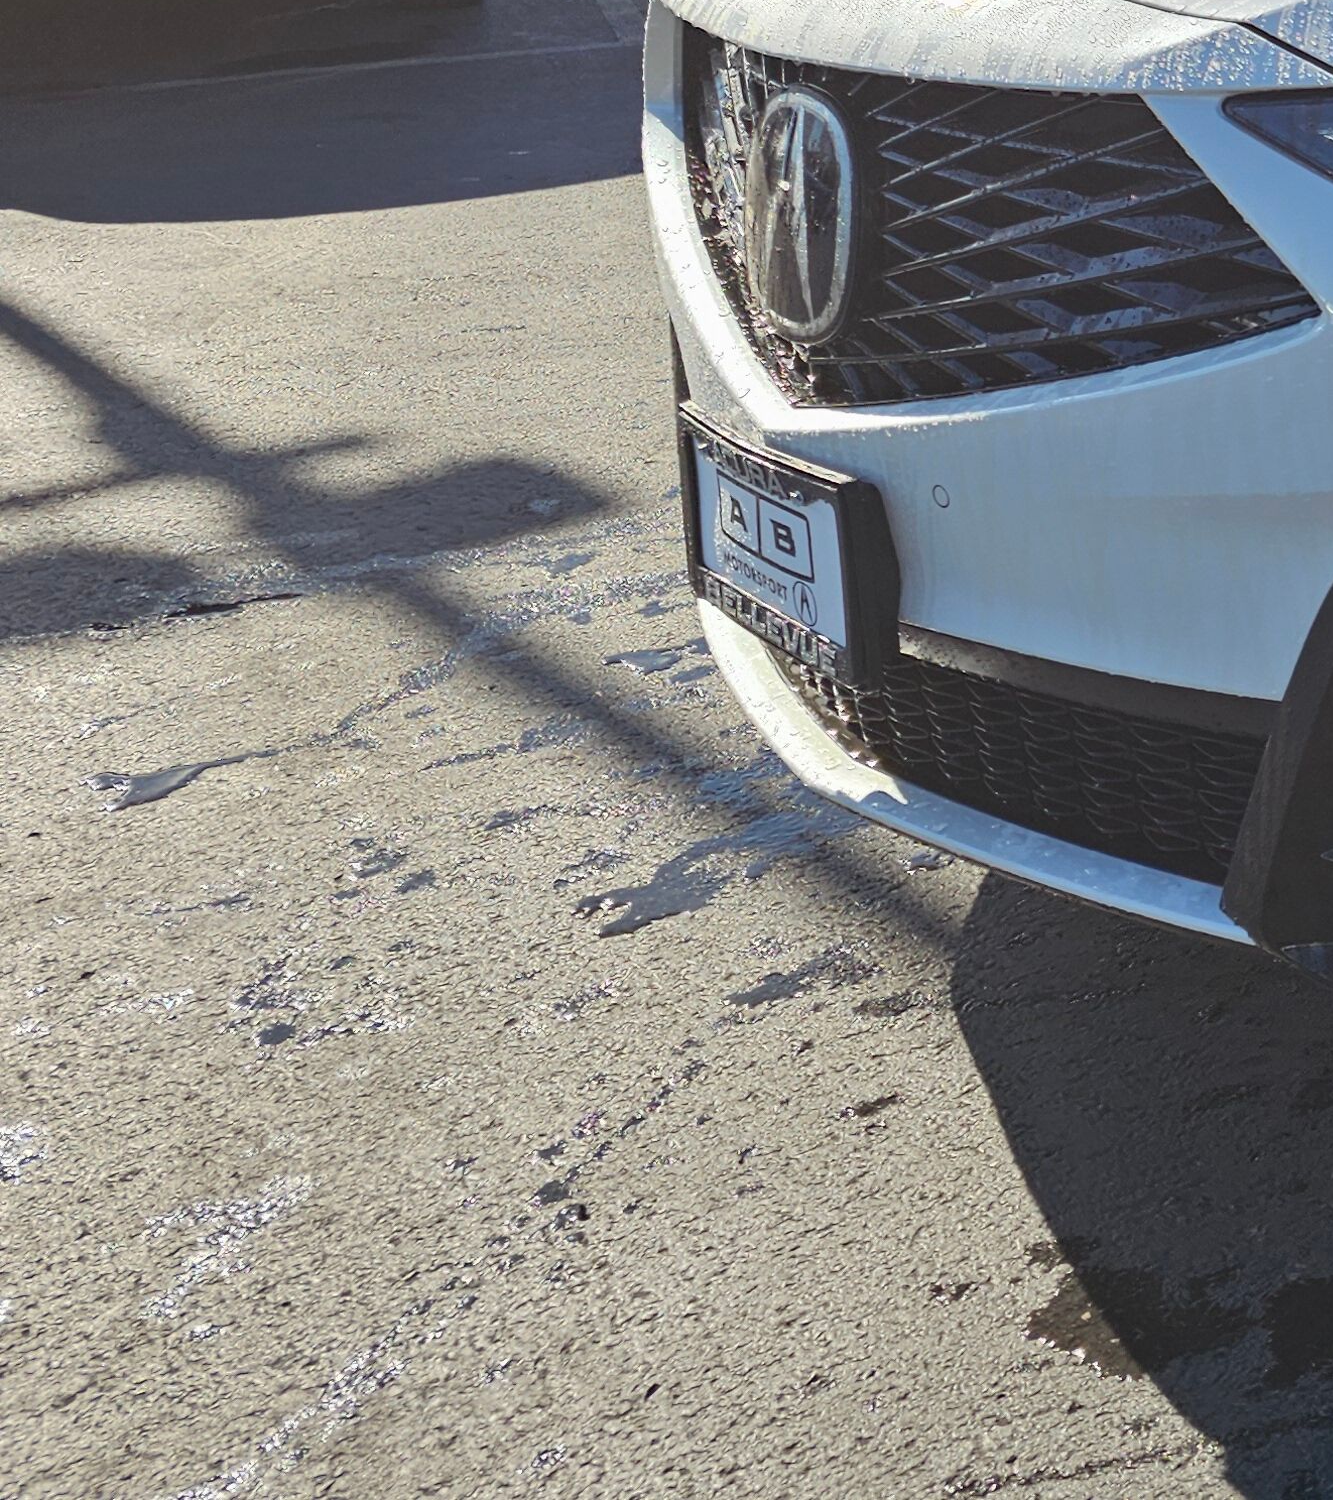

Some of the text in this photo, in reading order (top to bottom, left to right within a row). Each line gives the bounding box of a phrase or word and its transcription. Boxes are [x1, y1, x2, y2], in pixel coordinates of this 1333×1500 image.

[730, 496, 797, 557] A B
[723, 551, 788, 601] MOTORSPORT
[705, 575, 837, 677] BELLEVUE
